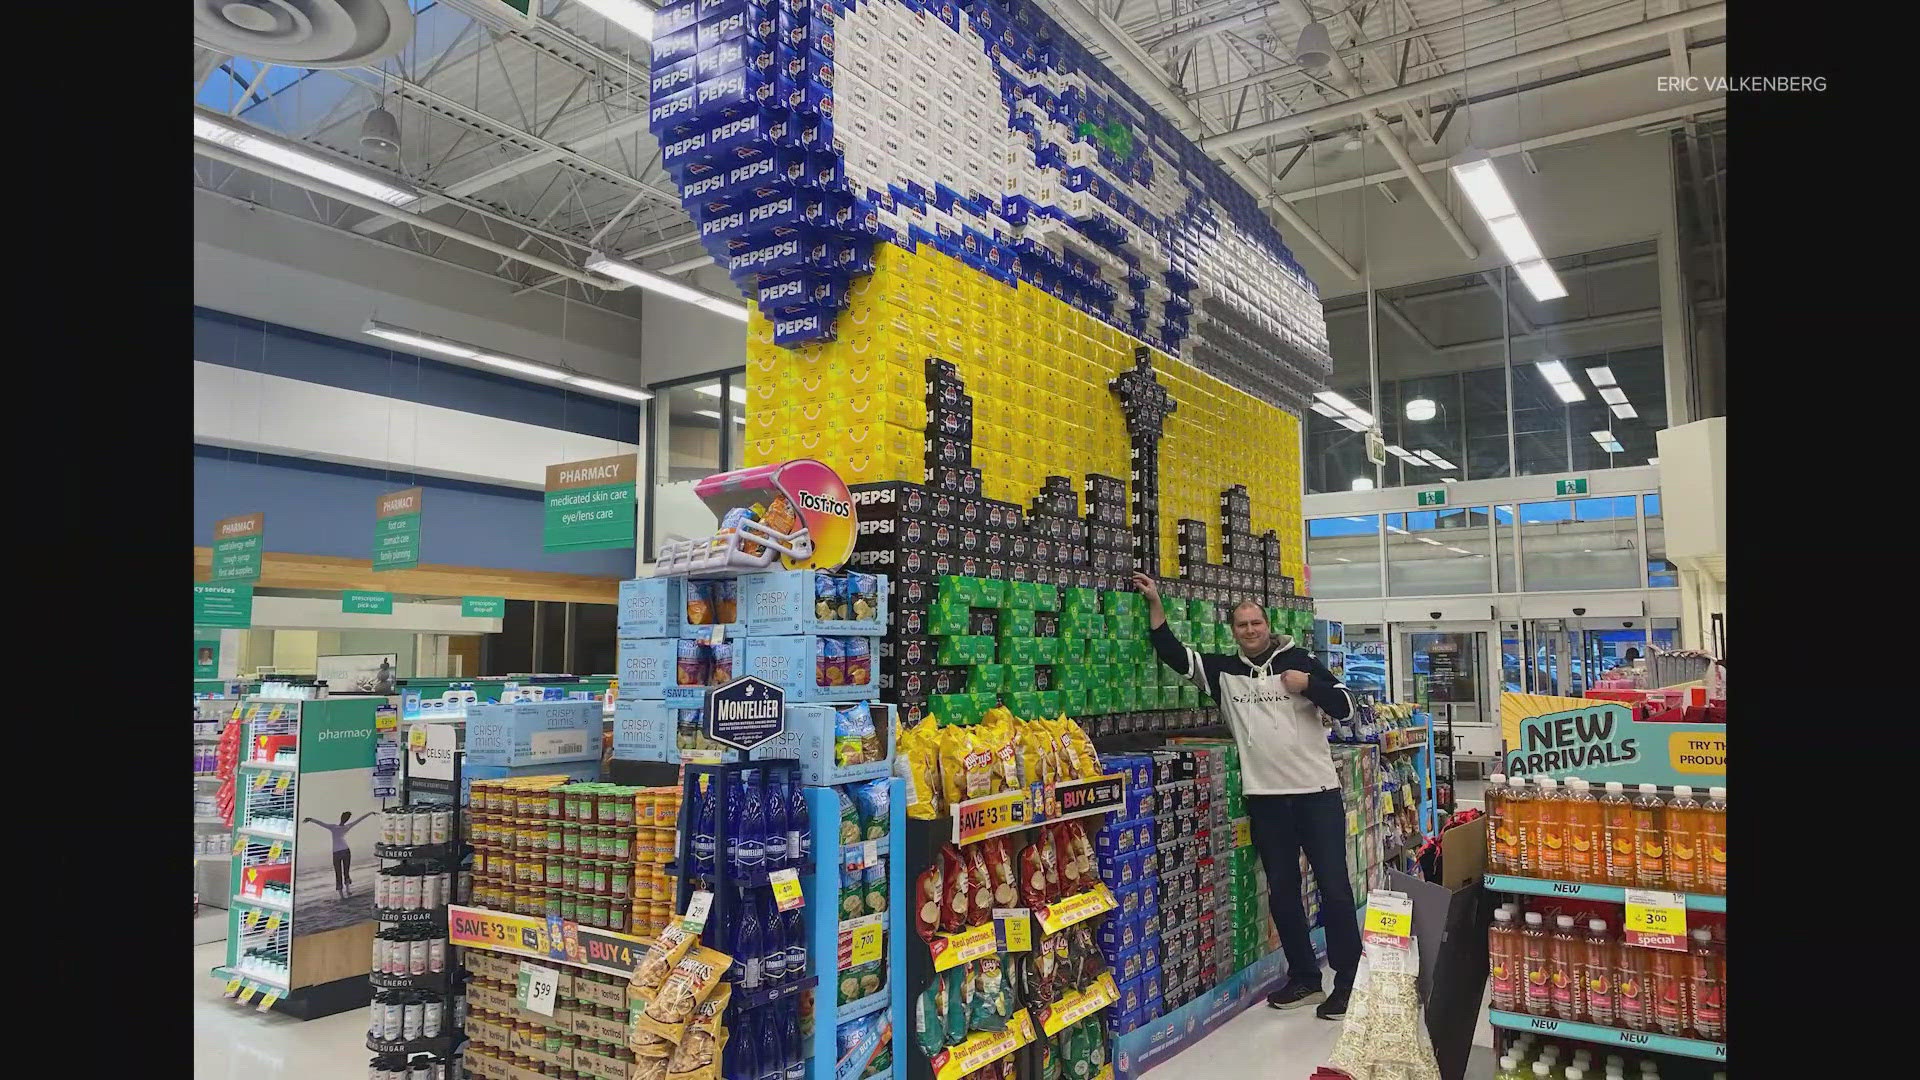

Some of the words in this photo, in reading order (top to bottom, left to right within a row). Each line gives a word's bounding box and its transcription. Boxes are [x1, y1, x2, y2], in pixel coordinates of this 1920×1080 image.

[700, 12, 744, 40] PEPSI
[653, 65, 693, 93] PEPSI
[699, 75, 742, 105] PEPSI
[652, 96, 692, 122] PEPSI
[665, 133, 705, 160] PEPSI
[730, 157, 774, 184] PEPSI
[684, 173, 725, 199] PEPSI
[750, 197, 793, 222] PEPSI
[703, 212, 744, 236] PEPSI
[732, 249, 765, 270] PEPS
[764, 240, 798, 267] EPSI
[761, 280, 802, 302] PEPSI
[777, 316, 818, 337] PEPSI
[560, 463, 620, 484] PHARMACY
[383, 496, 413, 513] PHARMACY
[550, 492, 590, 507] medicated
[592, 491, 608, 502] skin
[610, 490, 628, 501] care
[852, 489, 896, 506] PEPSI
[562, 510, 595, 525] eye/lens
[596, 509, 614, 519] care
[222, 520, 255, 535] PHARMACY
[851, 549, 895, 565] PEPSI
[351, 595, 385, 603] prescription
[357, 601, 379, 609] pick-up
[667, 688, 687, 698] SAVE
[1232, 695, 1290, 704] SEAHAWKS
[319, 729, 372, 742] pharmacy
[1527, 711, 1614, 752] NEW
[1688, 740, 1711, 750] TRY
[426, 748, 451, 760] CELSIUS
[1509, 738, 1637, 777] ARRIVALS
[1063, 789, 1087, 809] BUY
[1087, 788, 1096, 804] 4
[986, 807, 998, 824] $3
[1553, 883, 1581, 894] NEW
[401, 913, 431, 921] SUGAR
[455, 917, 490, 938] SAVE
[491, 923, 505, 940] $3
[951, 937, 966, 949] Real
[1638, 936, 1675, 946] special
[589, 940, 619, 963] BUY
[620, 948, 632, 966] 4
[383, 979, 413, 987] ENERGY
[1531, 1019, 1559, 1030] NEW
[1620, 1032, 1649, 1044] NEW
[953, 1050, 968, 1061] Real
